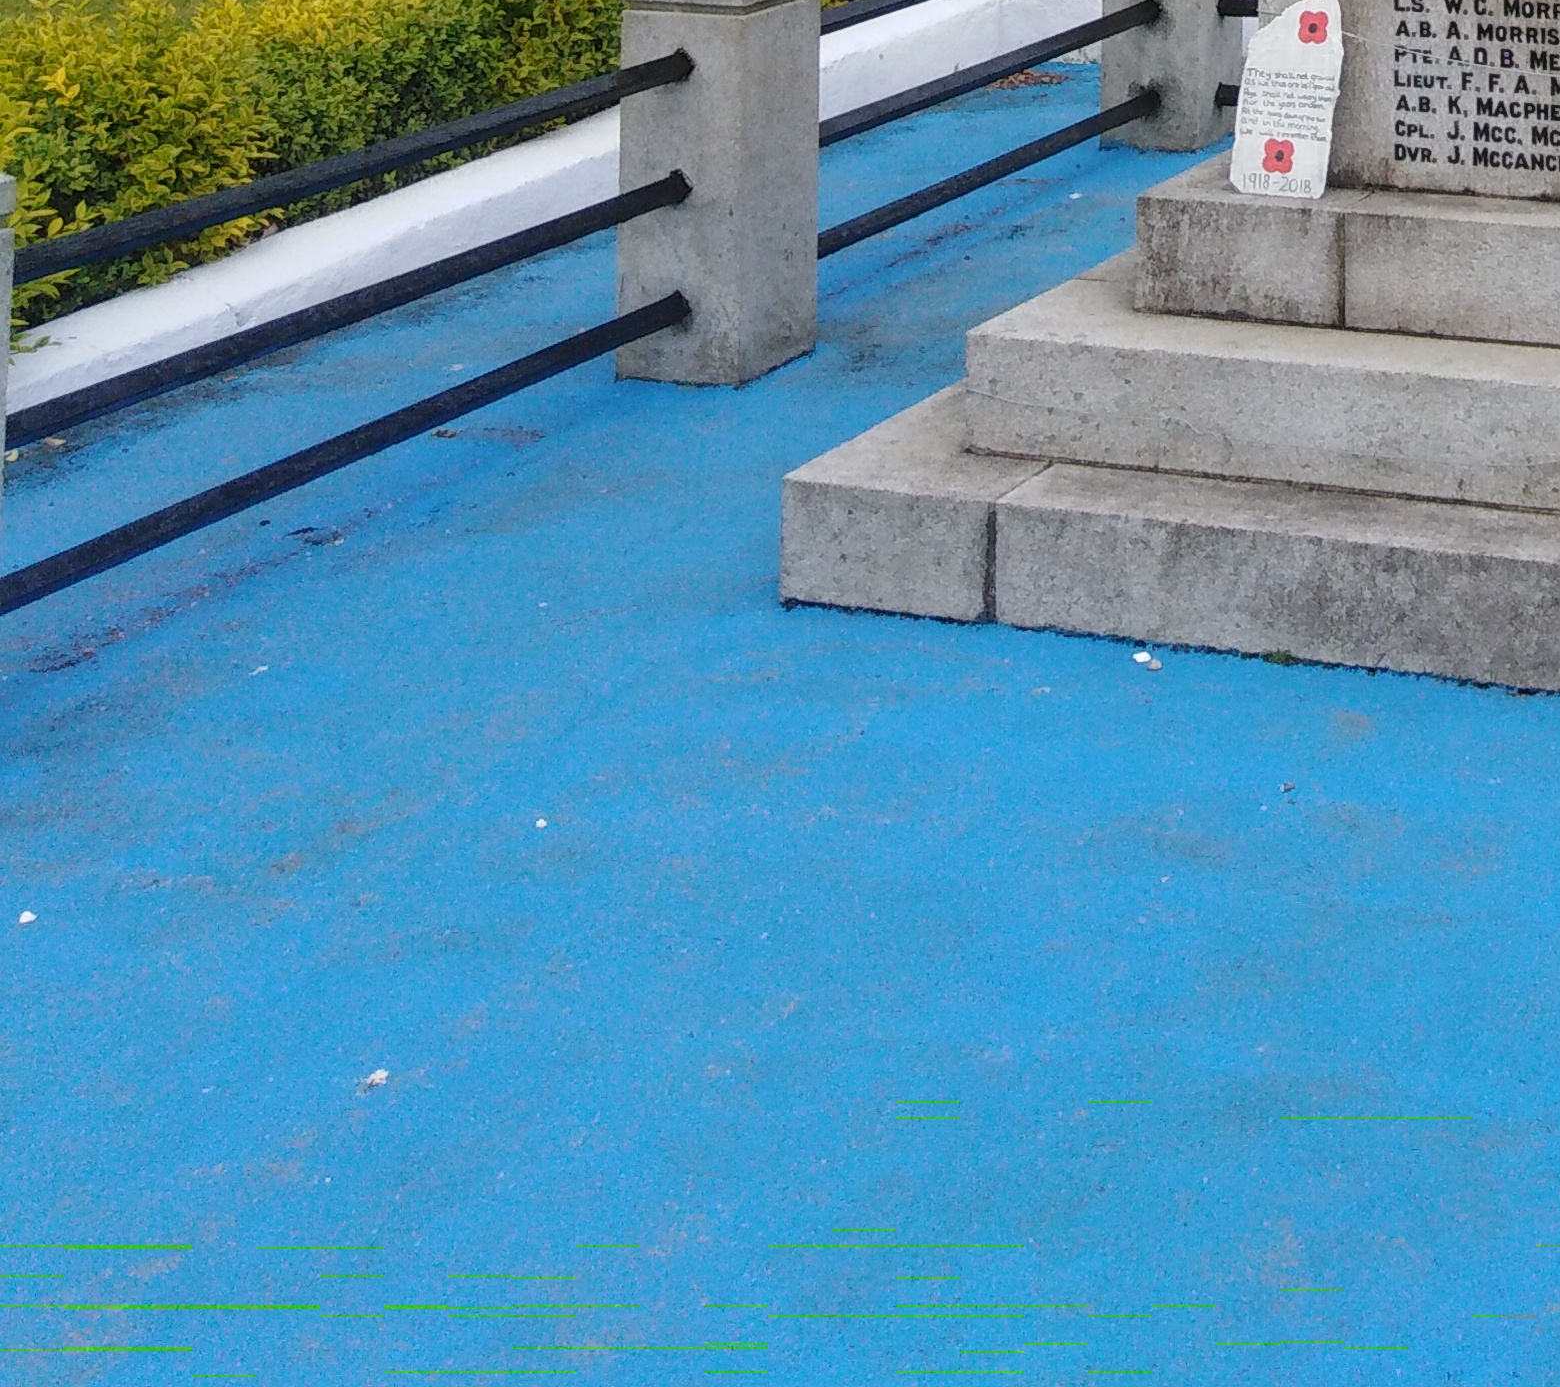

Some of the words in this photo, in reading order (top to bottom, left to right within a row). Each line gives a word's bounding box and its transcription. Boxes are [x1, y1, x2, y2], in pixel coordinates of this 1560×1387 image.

[1395, 20, 1437, 39] A.B.
[1446, 20, 1469, 40] A.
[1500, 48, 1520, 69] B.
[1461, 72, 1480, 93] F.
[1488, 73, 1505, 93] F.
[1514, 75, 1537, 95] A.
[1395, 94, 1437, 114] A.B.
[1447, 120, 1466, 141] J.
[1448, 146, 1465, 166] J.
[1242, 173, 1312, 193] 1918-2018
